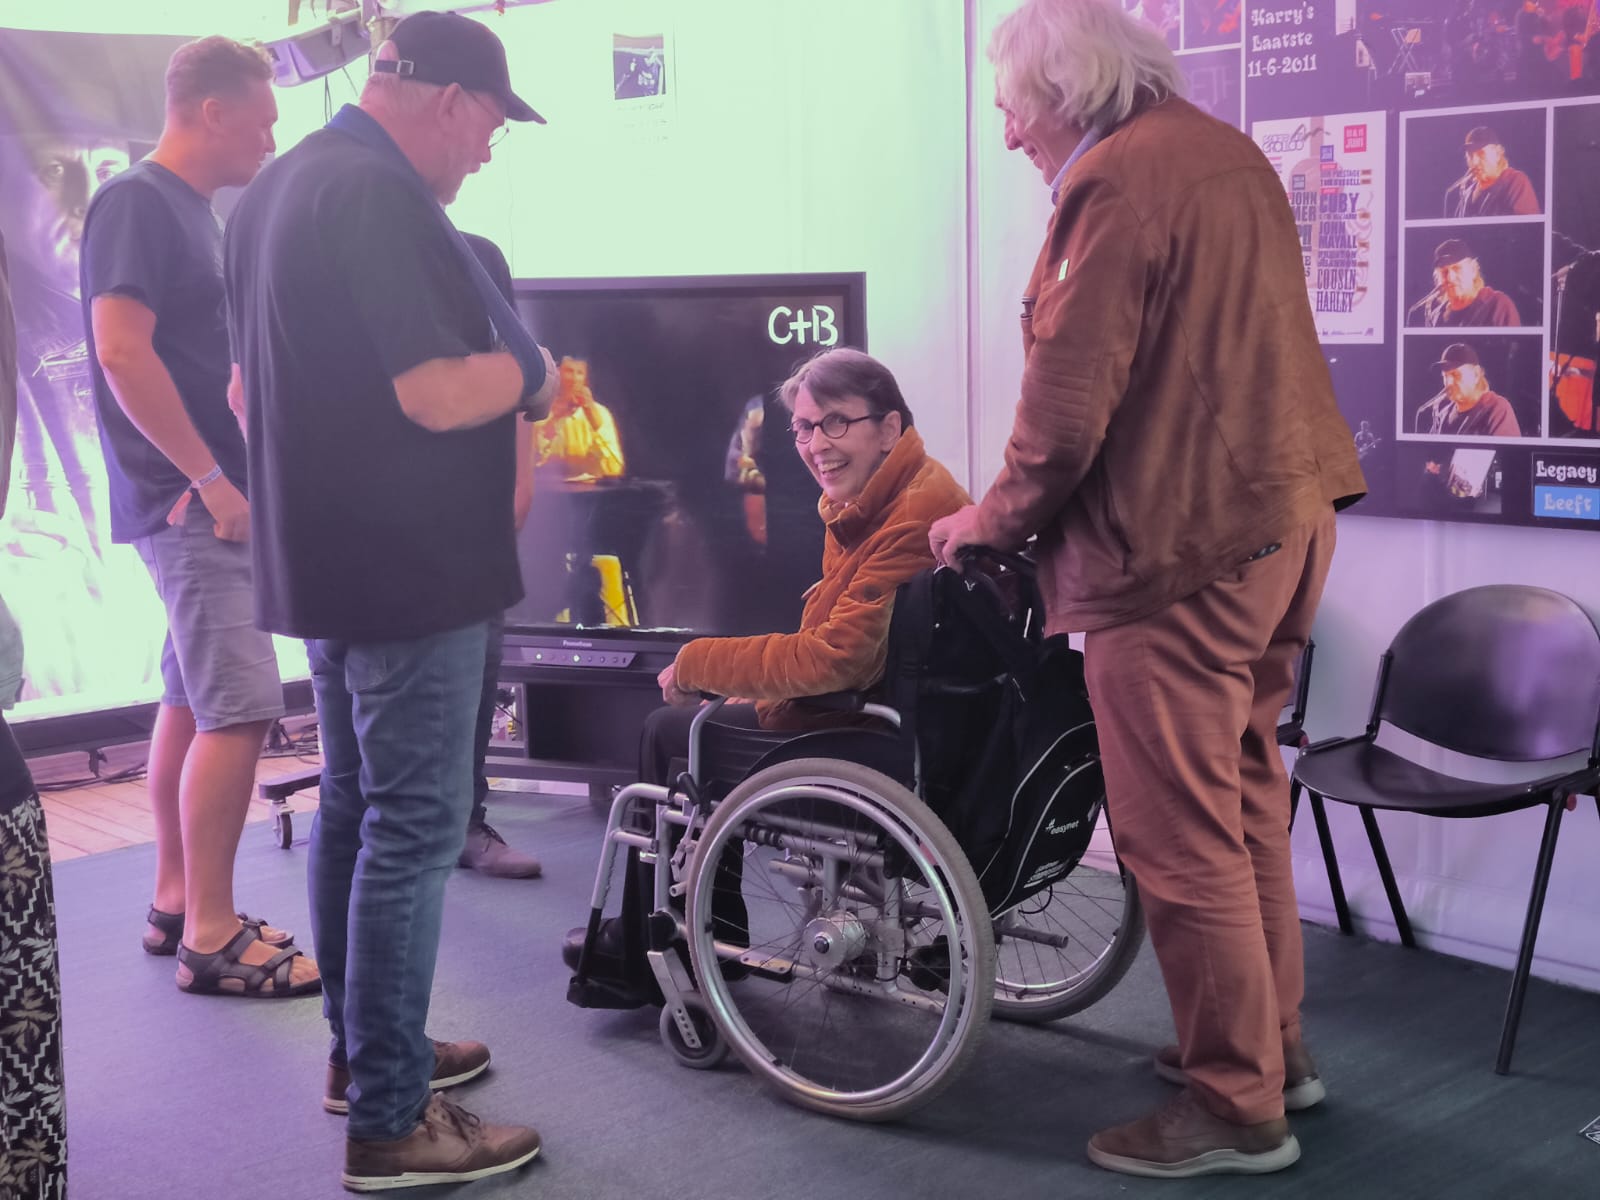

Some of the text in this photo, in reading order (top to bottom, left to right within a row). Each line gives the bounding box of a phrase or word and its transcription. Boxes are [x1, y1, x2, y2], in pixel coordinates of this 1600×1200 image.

[1251, 1, 1314, 26] Harry's
[1252, 32, 1313, 52] Laatste
[1247, 54, 1317, 77] 11-6-2011
[1317, 269, 1356, 290] COUSIN
[1316, 291, 1354, 312] HARLEY
[767, 305, 839, 346] C+B
[1536, 460, 1597, 484] Legacy
[1544, 493, 1593, 515] Leeft
